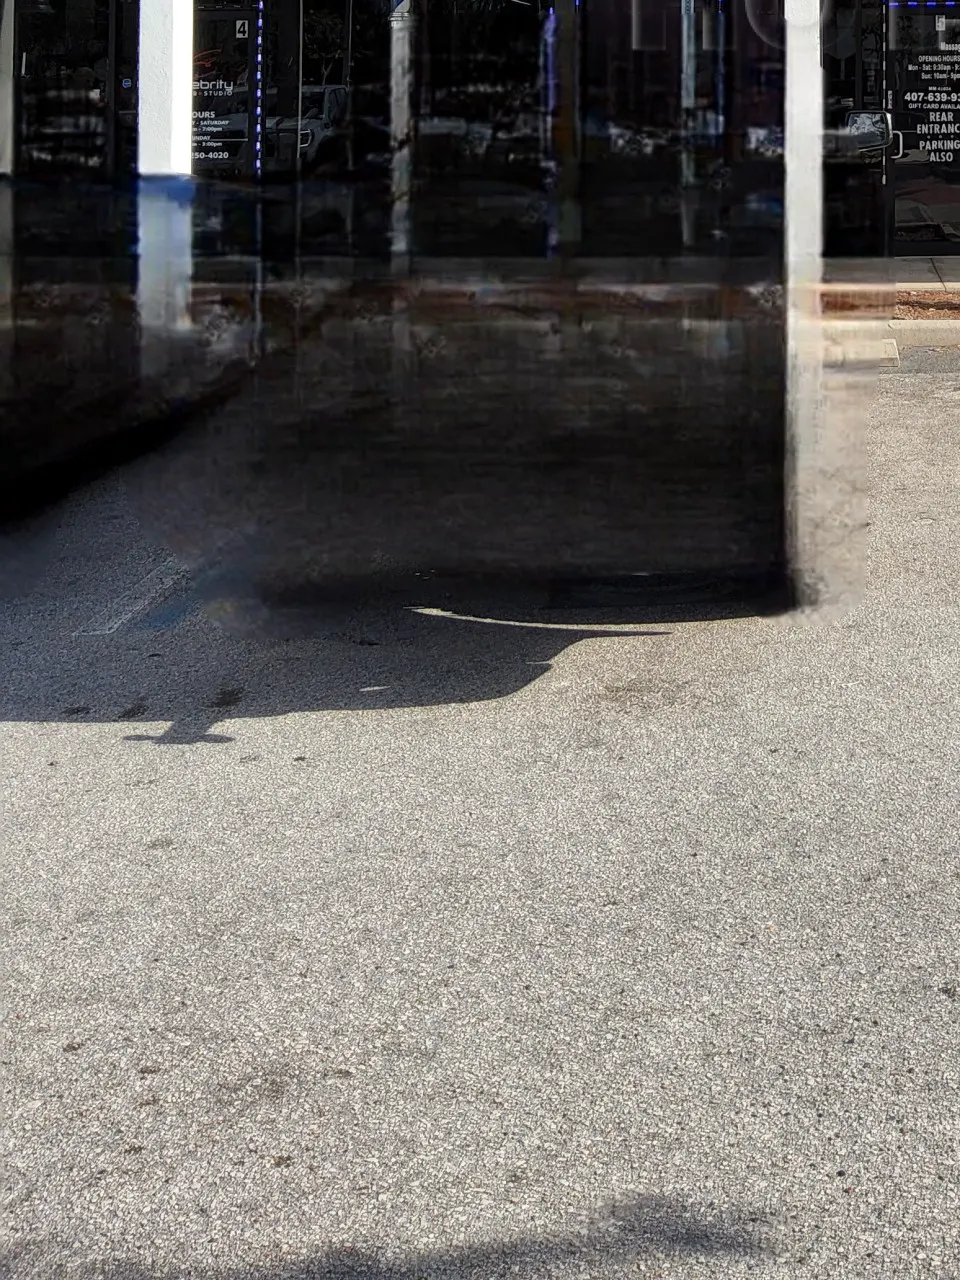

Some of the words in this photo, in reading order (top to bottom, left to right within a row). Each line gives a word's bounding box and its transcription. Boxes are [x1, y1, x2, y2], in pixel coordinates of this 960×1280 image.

[237, 21, 247, 37] 4
[192, 79, 233, 91] ebrity
[192, 111, 215, 119] OURS
[929, 111, 954, 121] REAR
[919, 140, 960, 150] PARKING
[929, 152, 953, 162] ALSO
